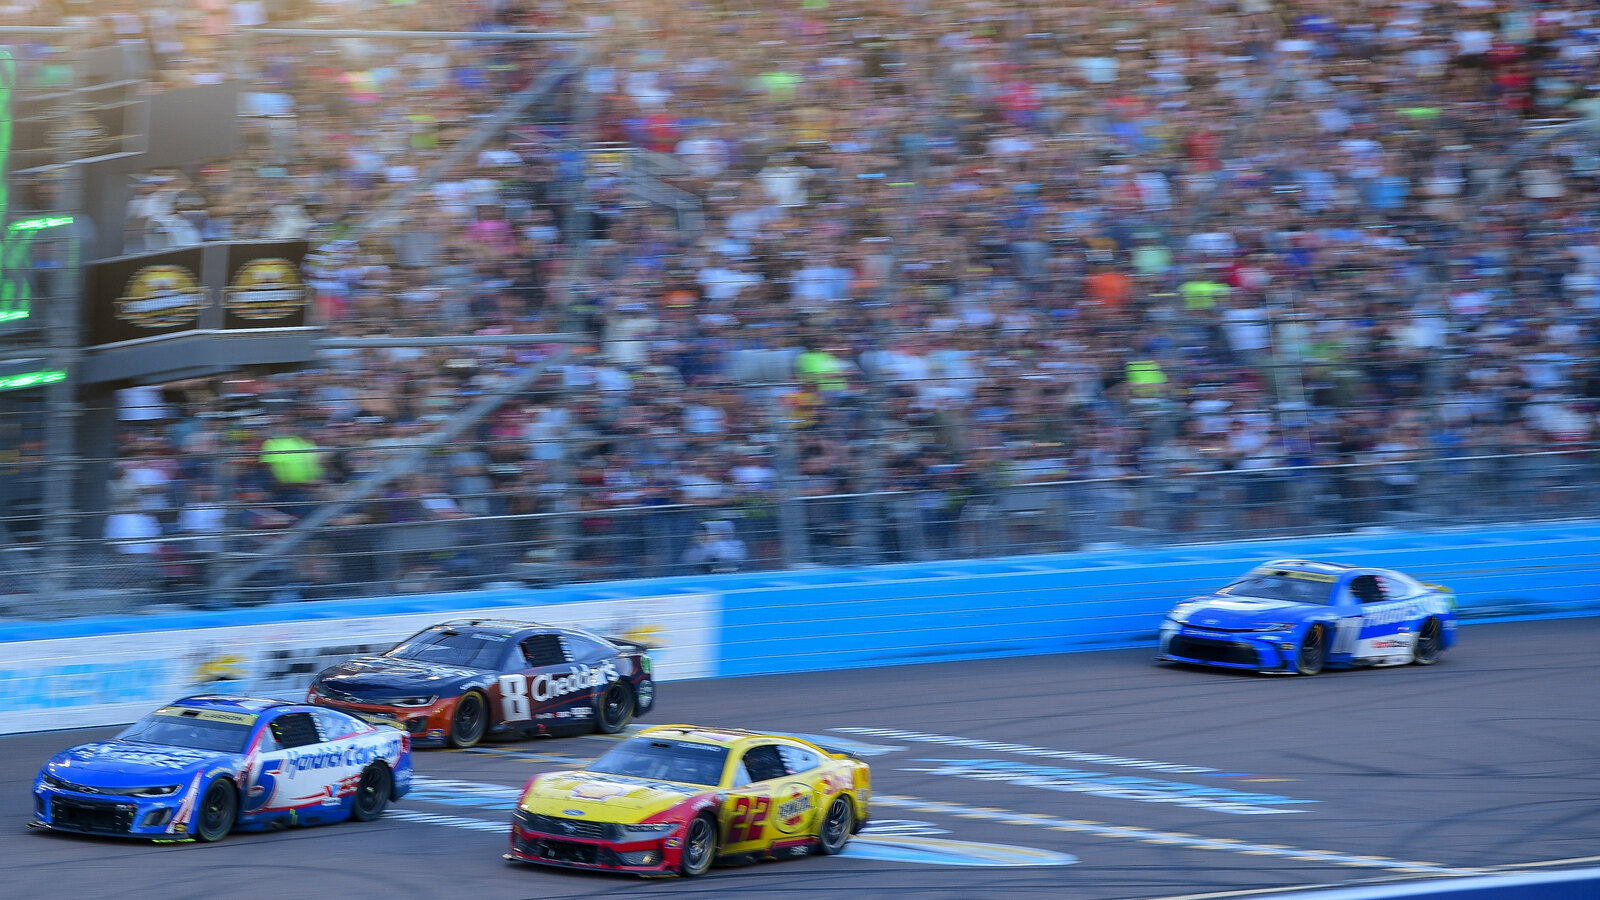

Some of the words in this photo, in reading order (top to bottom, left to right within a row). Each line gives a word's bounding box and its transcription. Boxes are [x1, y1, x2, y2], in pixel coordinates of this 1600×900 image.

[498, 674, 532, 721] 8
[531, 659, 620, 702] Cheddar's
[246, 758, 284, 812] 5
[727, 796, 771, 843] 22
